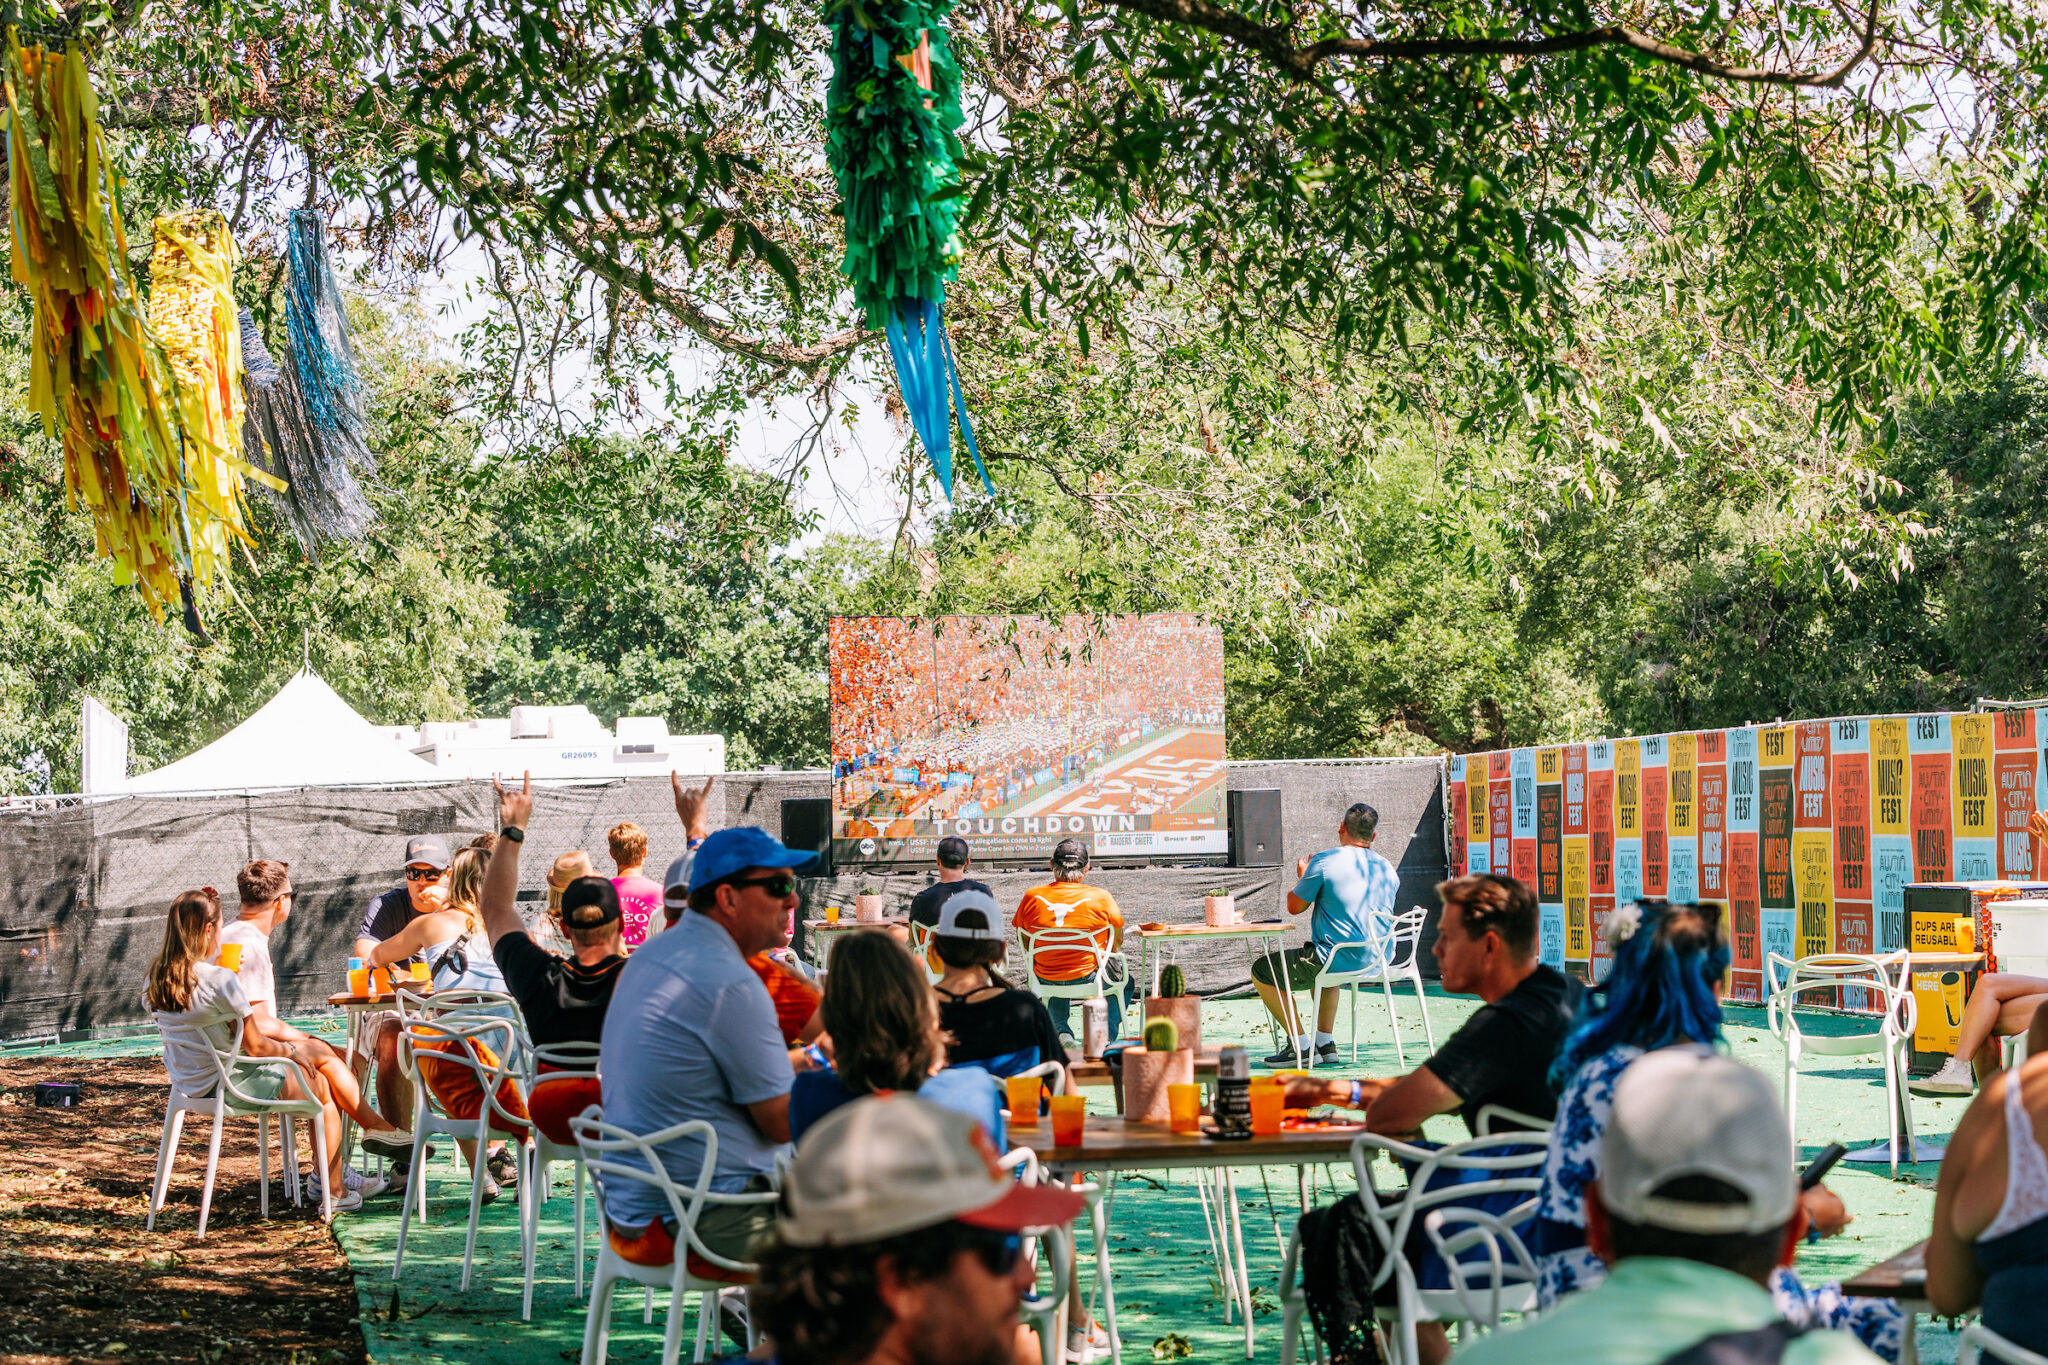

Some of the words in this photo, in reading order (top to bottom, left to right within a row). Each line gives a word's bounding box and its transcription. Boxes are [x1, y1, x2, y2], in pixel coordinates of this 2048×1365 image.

[1839, 720, 1859, 740] FEST
[1882, 720, 1897, 737] CITY
[1918, 716, 1940, 740] FEST
[1963, 718, 1981, 736] CITY
[2004, 710, 2026, 738] FEST
[1646, 738, 1660, 755] FEST
[1704, 732, 1719, 752] FEST
[1766, 732, 1784, 756] FEST
[1542, 753, 1556, 774] FEST
[1800, 756, 1826, 792] MUSIC
[1672, 770, 1692, 802] MUSIC
[1732, 760, 1754, 796] MUSIC
[1878, 758, 1902, 796] MUSIC
[1958, 758, 1988, 798] MUSIC
[2002, 770, 2032, 788] AUSTIN
[1618, 774, 1636, 805] MUSIC
[1843, 788, 1859, 804] CITY
[1924, 790, 1940, 806] CITY
[2008, 791, 2027, 808] CITY
[1706, 797, 1719, 811] CITY
[1734, 797, 1751, 820] FEST
[1768, 802, 1783, 818] CITY
[1804, 793, 1824, 818] FEST
[1882, 798, 1902, 824] FEST
[1963, 800, 1986, 826] FEST
[932, 815, 1134, 836] TOUCHDOWN
[1518, 808, 1530, 828] FEST
[1568, 805, 1582, 826] FEST
[1622, 808, 1635, 828] FEST
[1674, 805, 1690, 827] FEST
[2004, 810, 2030, 828] LIMITS
[974, 838, 1010, 846] allegations
[1110, 836, 1132, 846] RAIDERS
[1135, 836, 1153, 846] CHIEFS
[1702, 832, 1722, 864] MUSIC
[1838, 826, 1865, 862] MUSIC
[1918, 829, 1946, 868] MUSIC
[1764, 838, 1789, 873] MUSIC
[2004, 832, 2032, 872] MUSIC
[1596, 864, 1609, 885] FEST
[1648, 864, 1662, 886] FEST
[1704, 866, 1720, 890] FEST
[1842, 864, 1863, 889] FEST
[1961, 859, 1988, 876] AUSTIN
[1544, 874, 1557, 895] FEST
[1768, 875, 1786, 899] FEST
[1884, 873, 1900, 889] CITY
[1568, 897, 1586, 928] MUSIC
[1735, 900, 1756, 934] MUSIC
[1802, 902, 1827, 938] MUSIC
[1841, 920, 1868, 936] AUSTIN
[1915, 920, 1937, 932] CUPS
[1570, 930, 1584, 950] FEST
[1738, 936, 1754, 960] FEST
[1846, 938, 1863, 954] CITY
[1916, 980, 1940, 992] HERE
